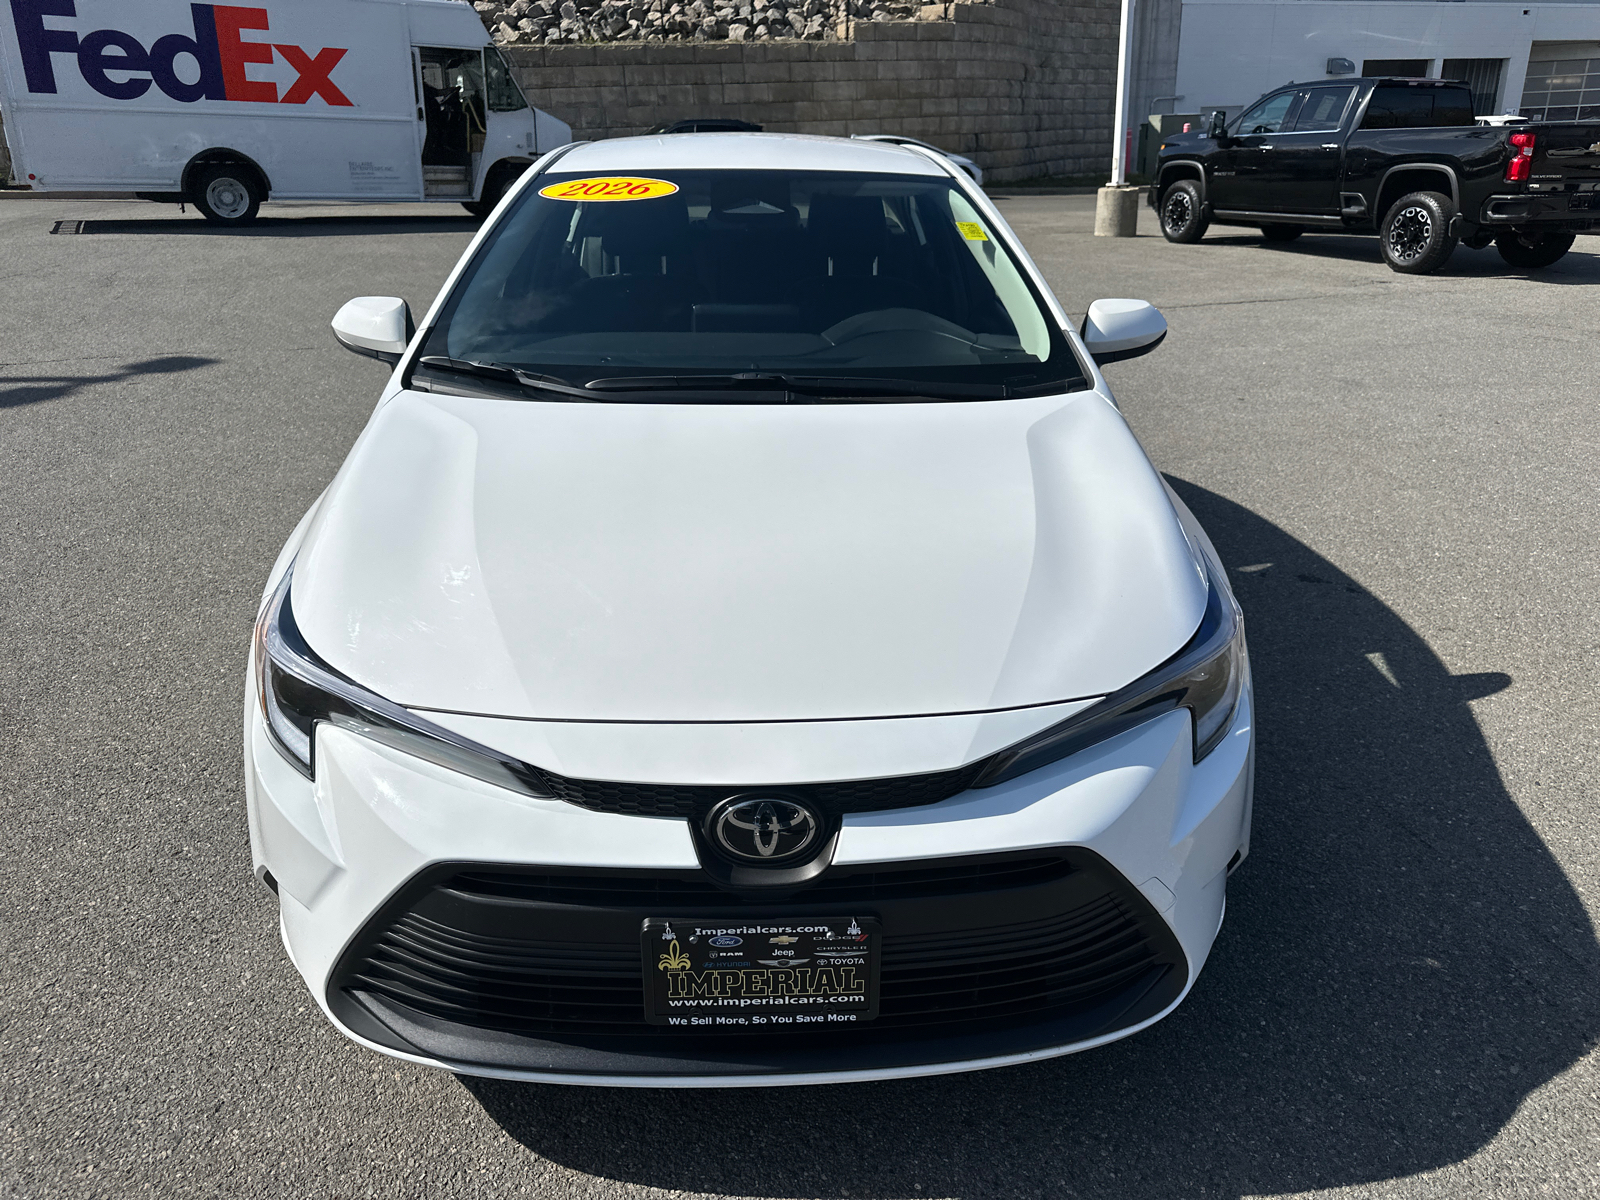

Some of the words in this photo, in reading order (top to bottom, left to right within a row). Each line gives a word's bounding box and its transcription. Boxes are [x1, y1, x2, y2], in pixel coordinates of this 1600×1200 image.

[10, 0, 355, 107] FedEx
[557, 181, 659, 197] 2026
[694, 925, 829, 937] Imperialcars.com
[771, 948, 795, 957] Jeep
[829, 958, 865, 966] TOYOTA
[667, 966, 865, 998] IMPERIAL
[668, 994, 865, 1008] www.imperialcars.com
[668, 1017, 688, 1026] We
[690, 1016, 713, 1026] Sell
[716, 1015, 749, 1026] More,
[752, 1015, 767, 1025] So
[770, 1014, 793, 1024] You
[795, 1013, 824, 1024] Save
[827, 1012, 857, 1023] More
